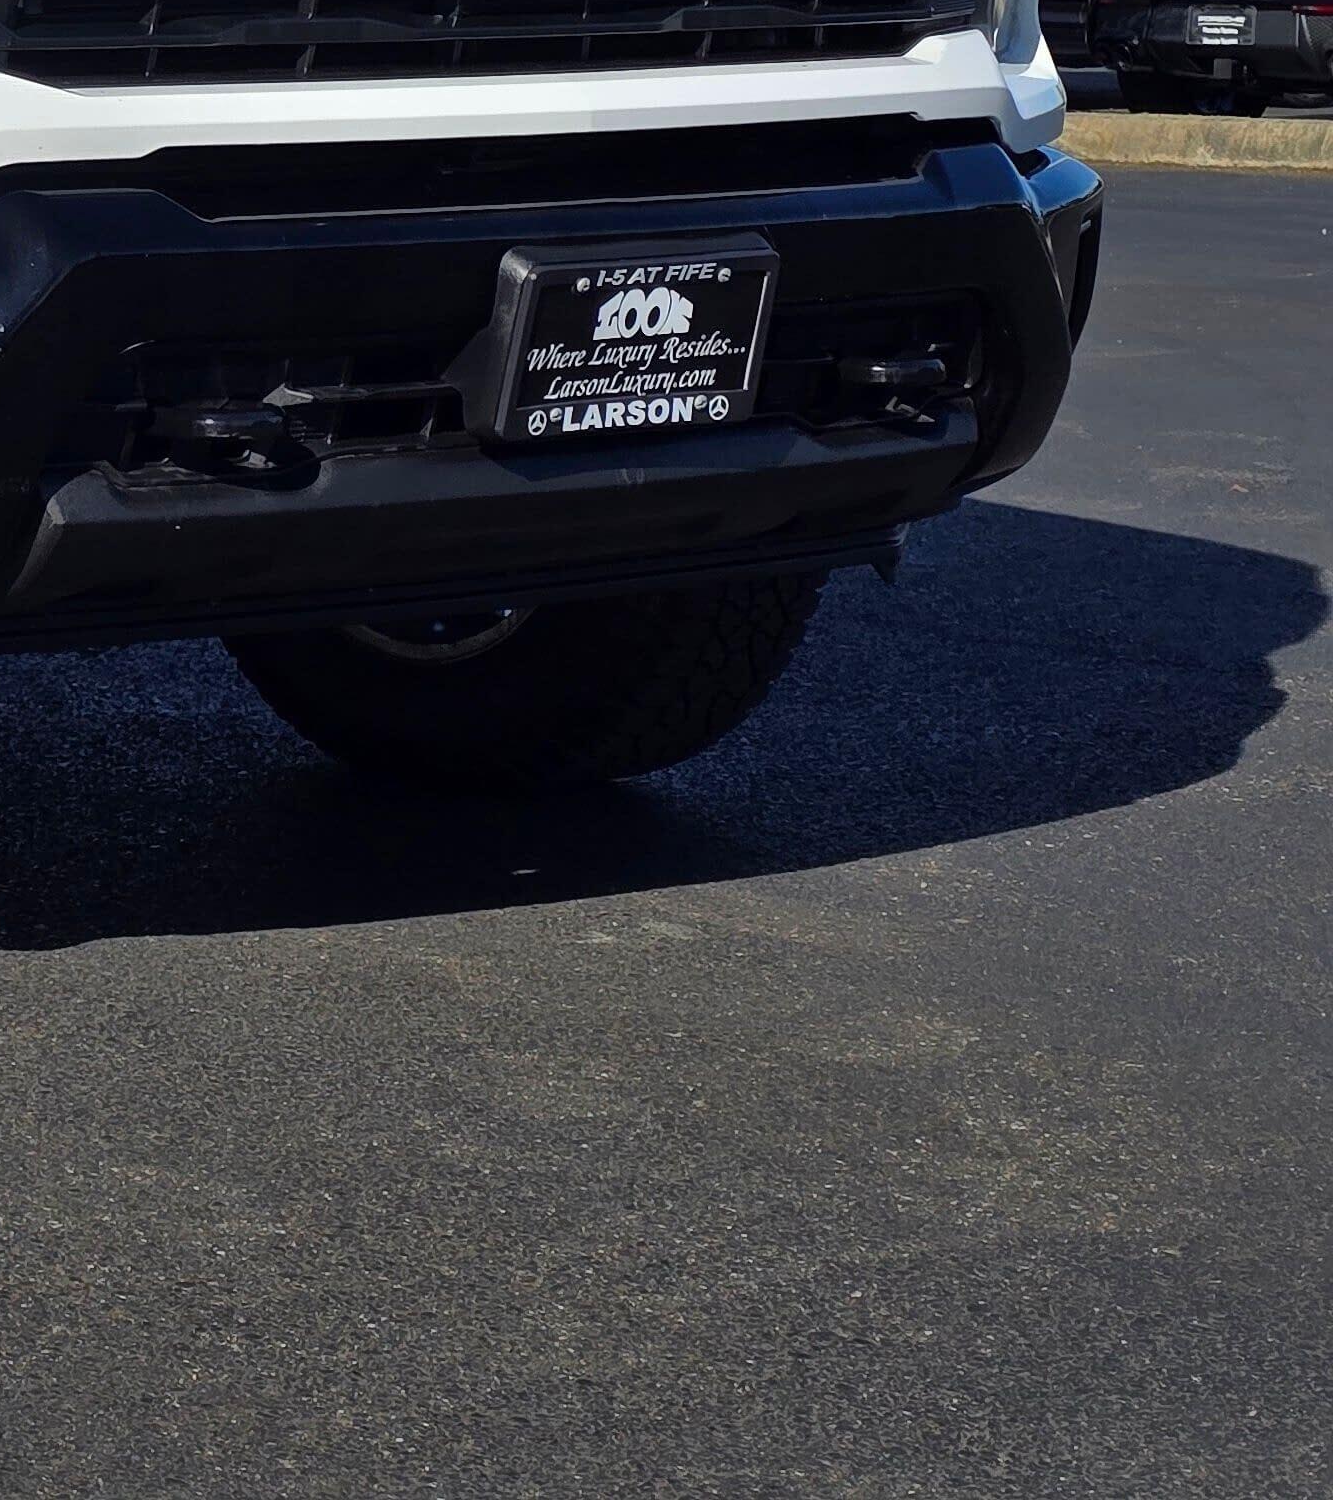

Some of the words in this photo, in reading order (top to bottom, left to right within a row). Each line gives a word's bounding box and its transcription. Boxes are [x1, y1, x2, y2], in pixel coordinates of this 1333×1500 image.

[597, 269, 628, 286] I-5
[627, 266, 663, 285] AT
[665, 262, 717, 282] FIFE
[527, 343, 586, 371] Where
[588, 343, 658, 371] Luxury
[659, 330, 746, 363] Resides...
[543, 368, 717, 400] LarsonLuxury.com
[562, 396, 695, 432] LARSON
